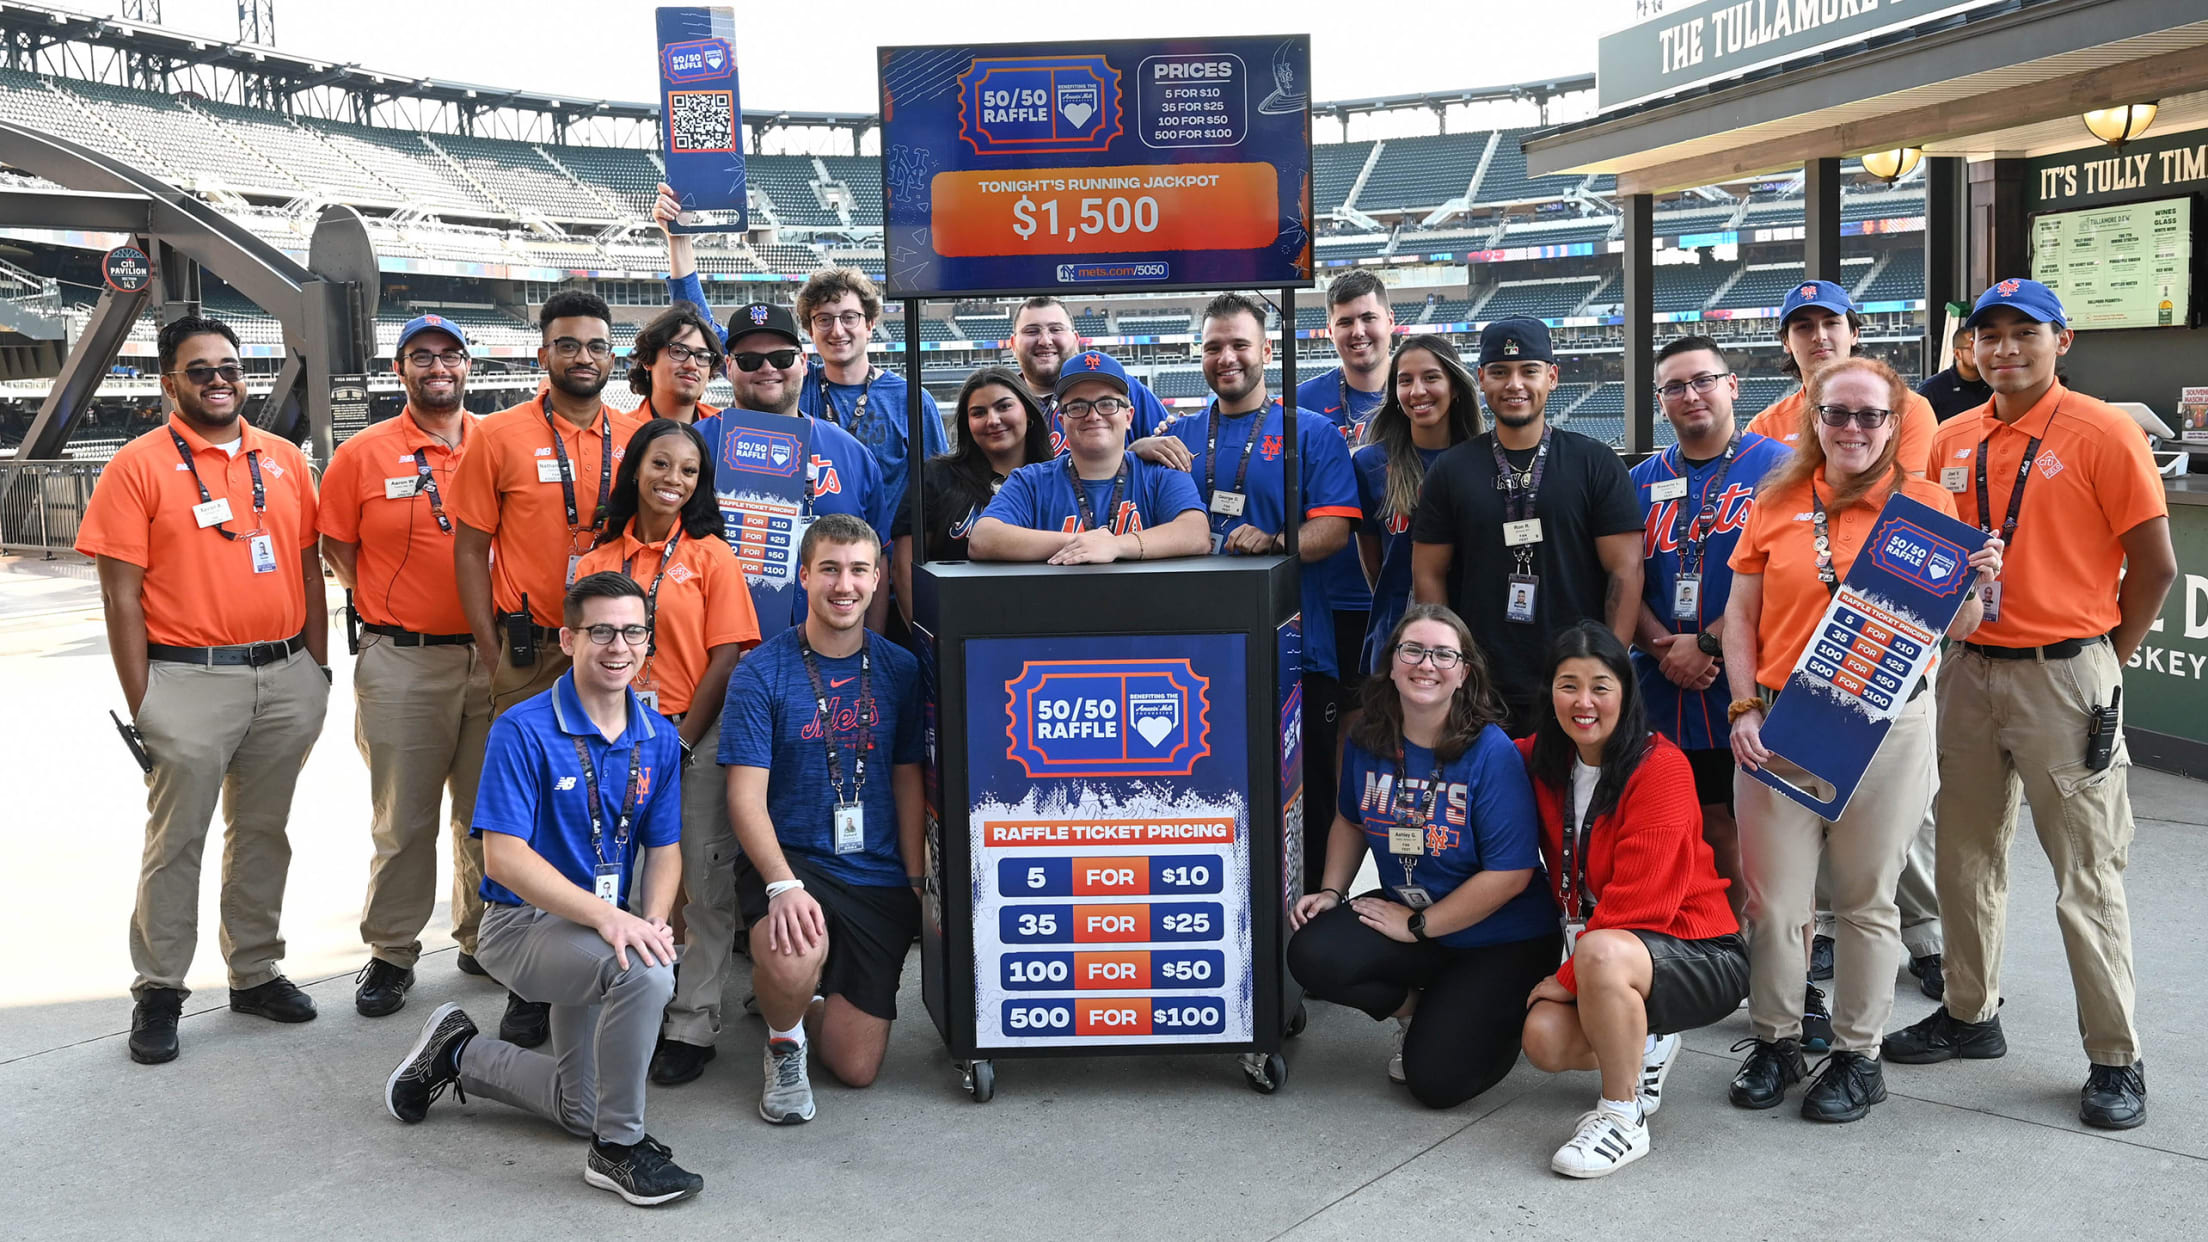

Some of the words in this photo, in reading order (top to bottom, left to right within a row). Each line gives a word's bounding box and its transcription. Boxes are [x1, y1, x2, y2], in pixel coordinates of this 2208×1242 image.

[1659, 17, 1704, 74] THE
[1711, 0, 1879, 58] TULLAM
[672, 54, 702, 65] 50/50
[673, 61, 703, 71] RAFFLE
[1154, 62, 1232, 79] PRICES
[984, 88, 1047, 108] 50/50
[1165, 89, 1172, 98] 5
[1174, 89, 1198, 98] FOR
[1200, 88, 1220, 97] $10
[984, 108, 1048, 123] RAFFLE
[1162, 103, 1176, 112] 35
[1178, 102, 1201, 111] FOR
[1204, 102, 1224, 111] $25
[1158, 117, 1179, 126] 100
[1181, 116, 1205, 125] FOR
[1207, 115, 1228, 124] $50
[1155, 130, 1176, 139] 500
[1179, 130, 1202, 139] FOR
[1204, 129, 1232, 138] $100
[2040, 165, 2077, 200] IT'S
[2084, 153, 2151, 194] TULLY
[2159, 144, 2208, 185] TIM
[978, 179, 1065, 193] TONIGHT'S
[1068, 177, 1140, 190] RUNNING
[1143, 174, 1220, 189] JACKPOT
[1012, 195, 1159, 243] $1,500
[2154, 218, 2177, 226] GLASS
[1078, 264, 1165, 277] mets.com/5050
[123, 281, 136, 289] 143
[736, 449, 767, 460] RAFFLE
[737, 441, 767, 452] 50/50
[811, 454, 842, 496] ts
[724, 529, 736, 537] 35
[770, 536, 786, 544] $25
[743, 548, 760, 556] FOR
[768, 551, 784, 559] $50
[1885, 545, 1924, 567] RAFFLE
[1890, 536, 1927, 560] 50/50
[763, 566, 785, 575] $100
[1841, 594, 1872, 613] RAFFLE
[1872, 609, 1899, 626] TICKET
[1898, 622, 1930, 642] PRICING
[1844, 614, 1855, 625] 5
[1866, 626, 1887, 641] FOR
[1895, 641, 1915, 655] $10
[1832, 629, 1849, 643] 35
[1856, 643, 1878, 658] FOR
[1885, 658, 1905, 672] $25
[1819, 644, 1842, 661] 100
[1847, 659, 1868, 674] FOR
[1875, 674, 1896, 689] $50
[2127, 646, 2207, 679] SKEY
[1810, 660, 1834, 677] 500
[1838, 676, 1859, 691] FOR
[1862, 689, 1889, 707] $100
[1038, 697, 1117, 722] 50/50
[1038, 721, 1117, 739] RAFFLE
[1360, 770, 1468, 826] METS
[993, 826, 1069, 841] RAFFLE
[1072, 825, 1144, 839] TICKET
[1147, 822, 1227, 838] PRICING
[1027, 867, 1046, 889] 5
[1086, 868, 1135, 886] FOR
[1162, 866, 1210, 886] $10
[1018, 914, 1057, 935] 35
[1087, 916, 1136, 933] FOR
[1162, 912, 1210, 933] $25
[1009, 961, 1068, 982] 100
[1088, 963, 1137, 980] FOR
[1162, 959, 1211, 980] $50
[1009, 1007, 1070, 1029] 500
[1089, 1009, 1137, 1026] FOR
[1153, 1006, 1219, 1027] $100
